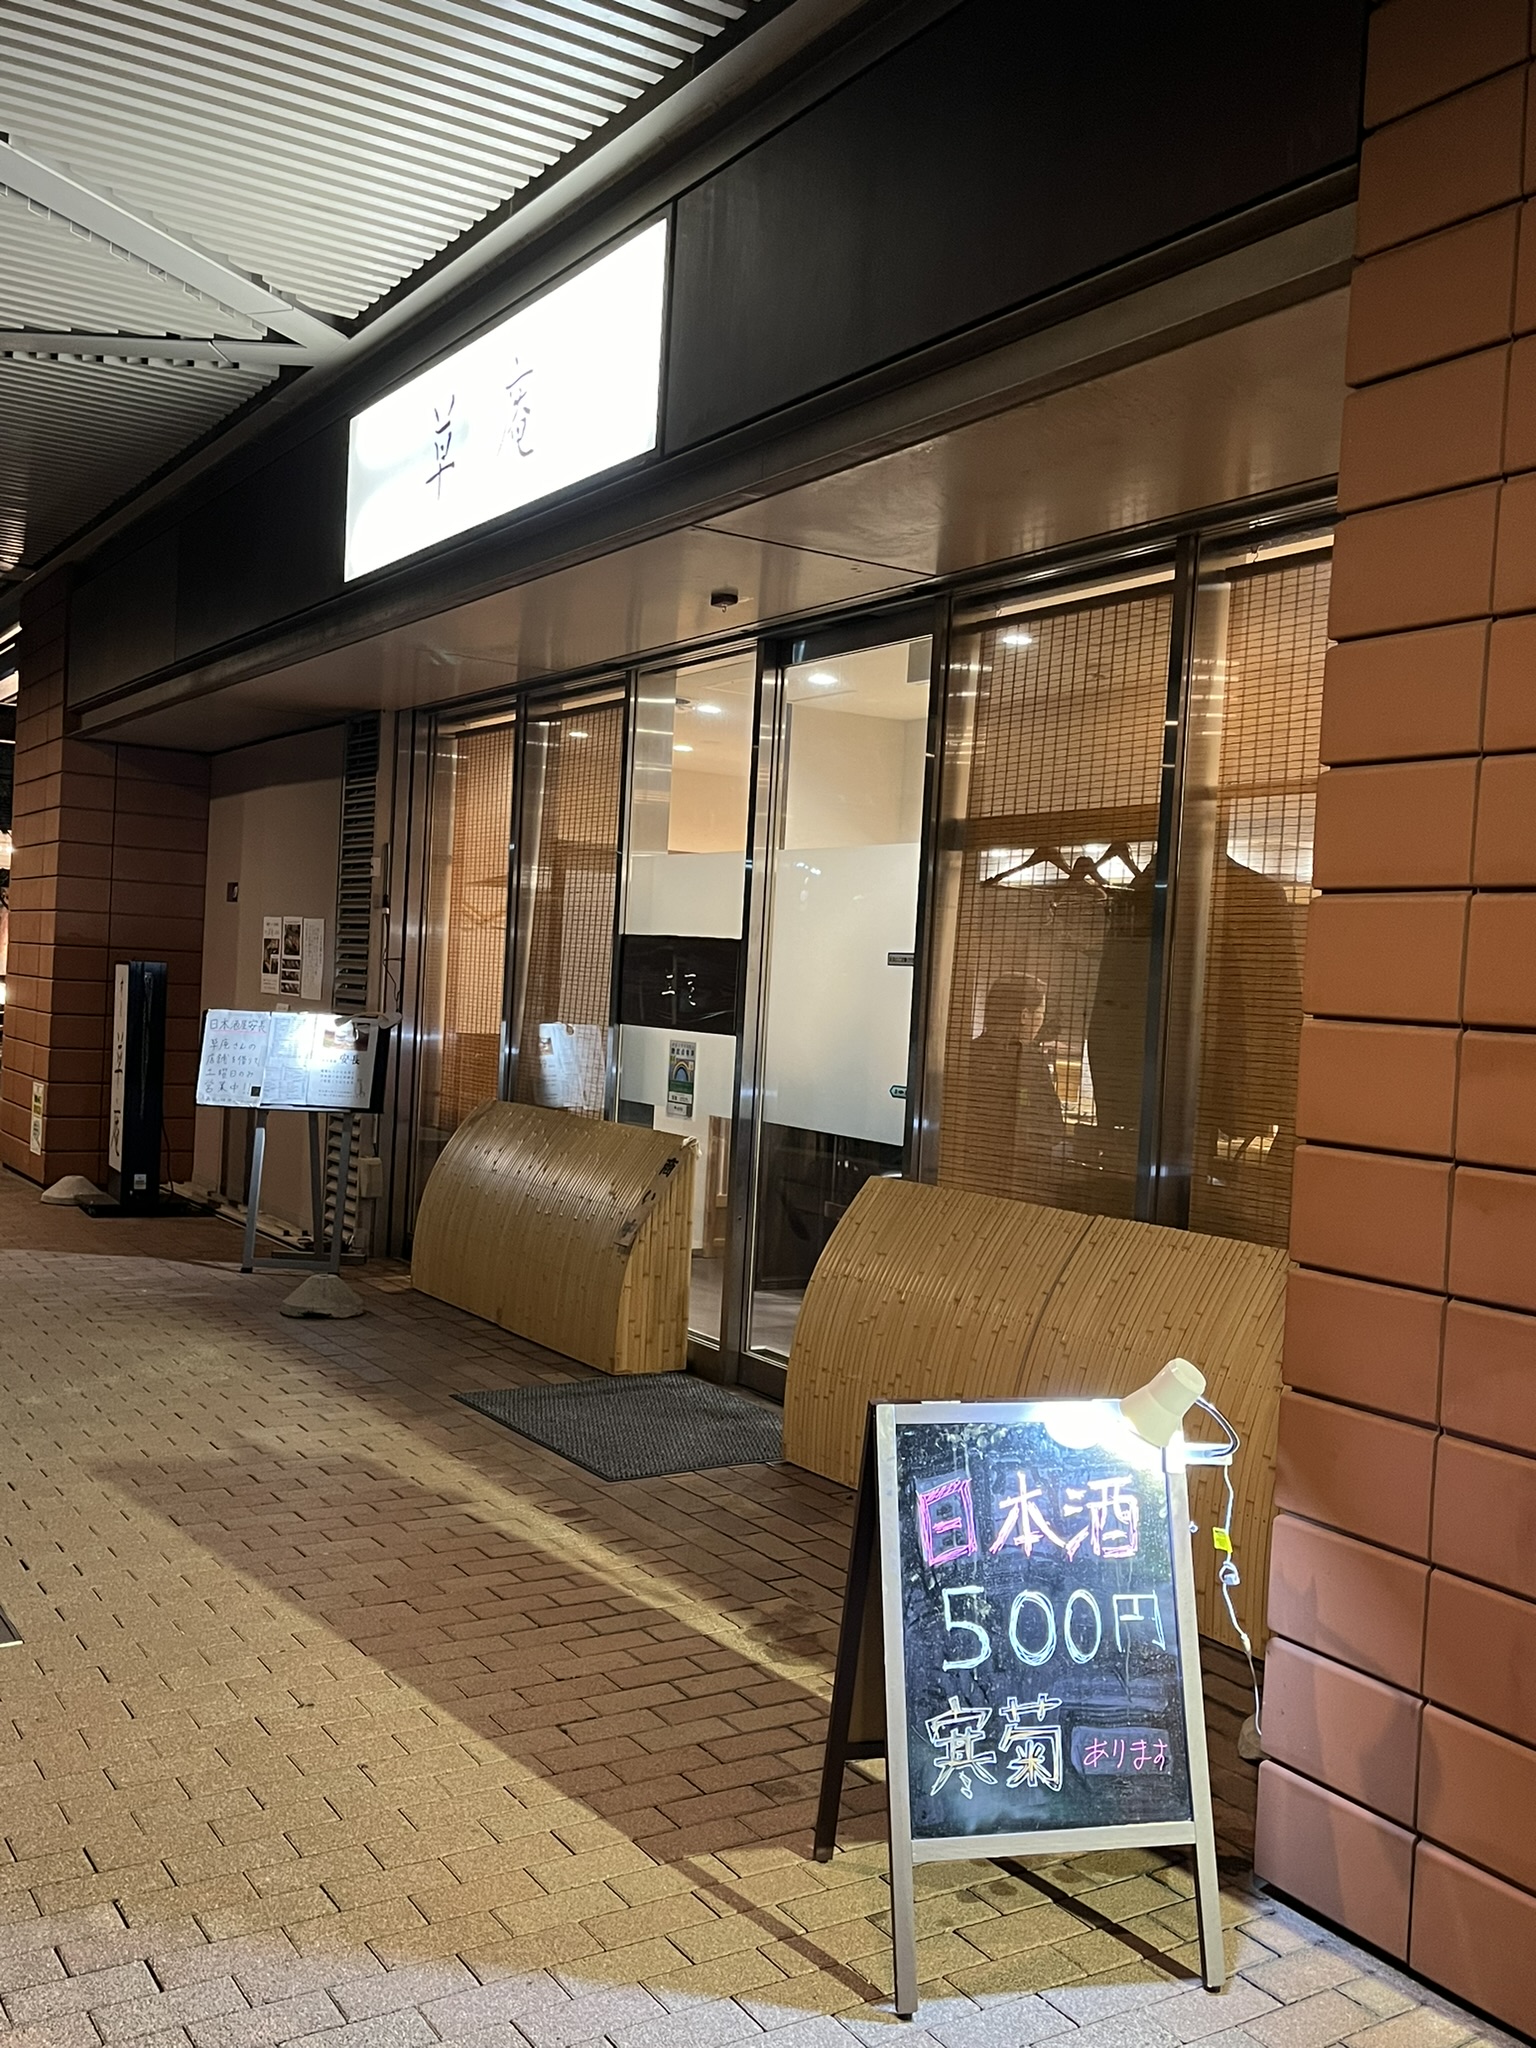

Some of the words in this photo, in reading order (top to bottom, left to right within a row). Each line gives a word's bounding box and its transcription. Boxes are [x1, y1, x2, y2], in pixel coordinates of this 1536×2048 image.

[425, 357, 534, 500] 草庵
[917, 1472, 1140, 1566] 日本酒
[941, 1585, 1167, 1672] 500円
[924, 1693, 1064, 1799] 寒菊
[1083, 1738, 1170, 1772] あります
